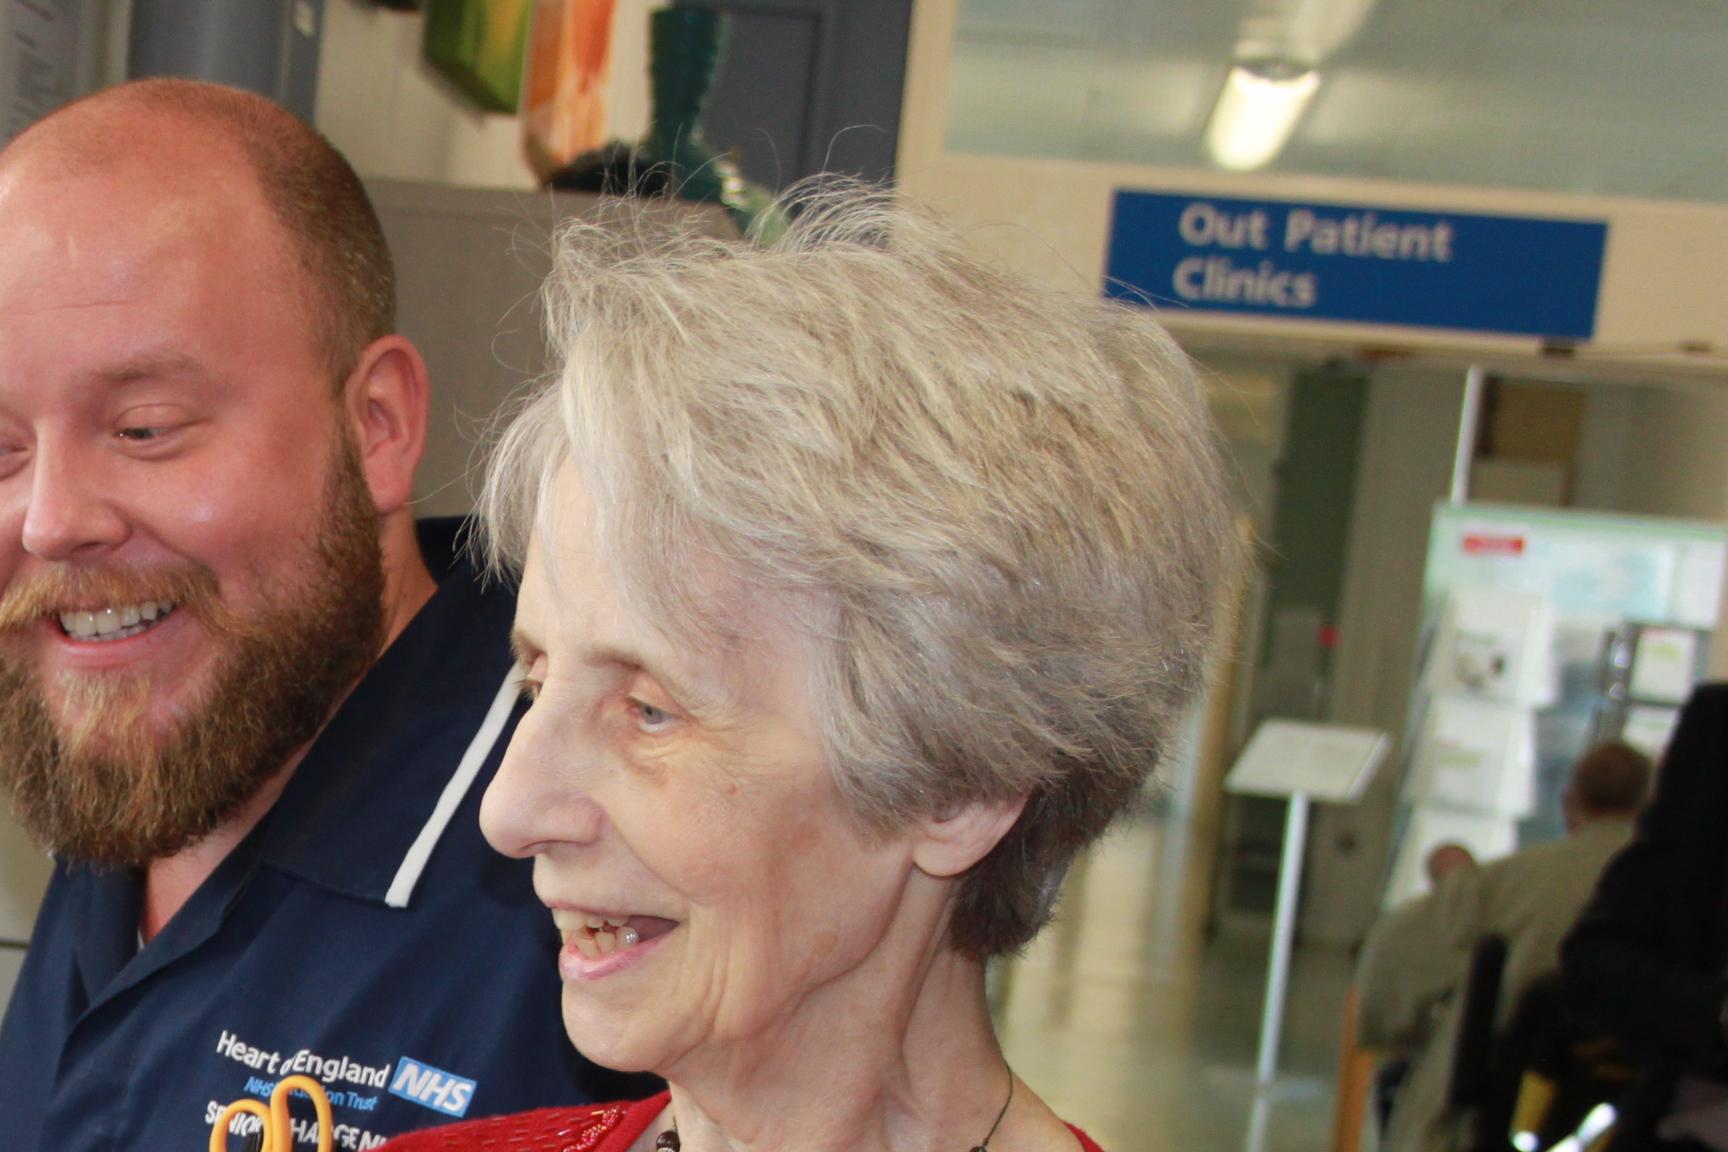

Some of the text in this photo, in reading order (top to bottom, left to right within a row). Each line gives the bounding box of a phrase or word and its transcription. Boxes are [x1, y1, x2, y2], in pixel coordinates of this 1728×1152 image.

[1178, 202, 1454, 263] Out Patient
[1172, 255, 1319, 308] Clinics
[216, 1030, 280, 1074] Heart
[293, 1049, 390, 1088] England
[346, 1091, 378, 1111] Trust
[392, 1064, 473, 1111] NHS
